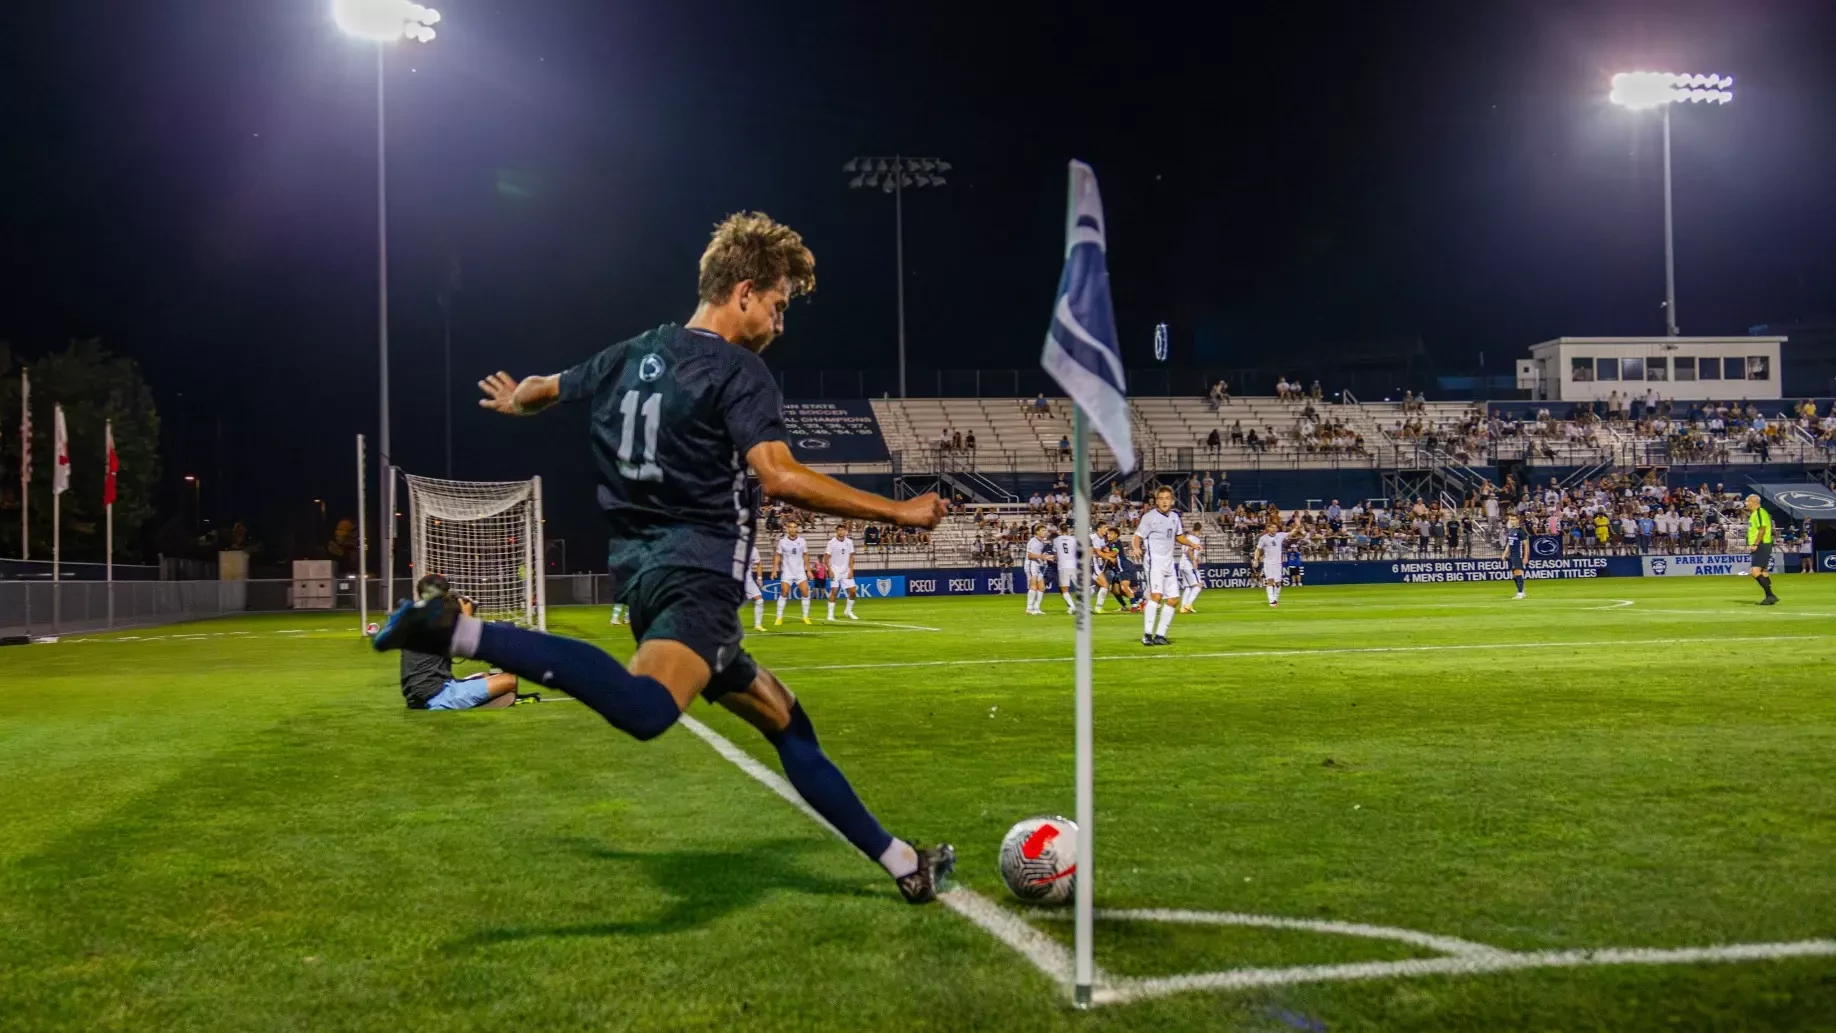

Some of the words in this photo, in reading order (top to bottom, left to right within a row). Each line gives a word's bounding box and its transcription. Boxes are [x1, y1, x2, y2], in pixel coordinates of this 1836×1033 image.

[617, 390, 663, 483] 11
[1062, 542, 1069, 554] 6
[1391, 564, 1399, 573] 6
[1401, 563, 1433, 573] MEN'S
[1435, 562, 1453, 572] BIG
[1454, 561, 1475, 571] TEN
[1528, 559, 1571, 569] SEASON
[1572, 558, 1608, 568] TITLES
[1675, 556, 1704, 565] PARK
[1706, 555, 1751, 564] AVENUE
[1207, 569, 1230, 579] CUP
[1403, 574, 1410, 583] 4
[1412, 573, 1445, 582] MEN'S
[1446, 572, 1464, 582] BIG
[1465, 571, 1487, 581] TEN
[1488, 569, 1560, 580] TOUAMENT
[1561, 568, 1598, 578] TITLES
[1695, 565, 1733, 575] ARMY
[910, 580, 936, 592] PSECU
[948, 579, 975, 591] PSECU
